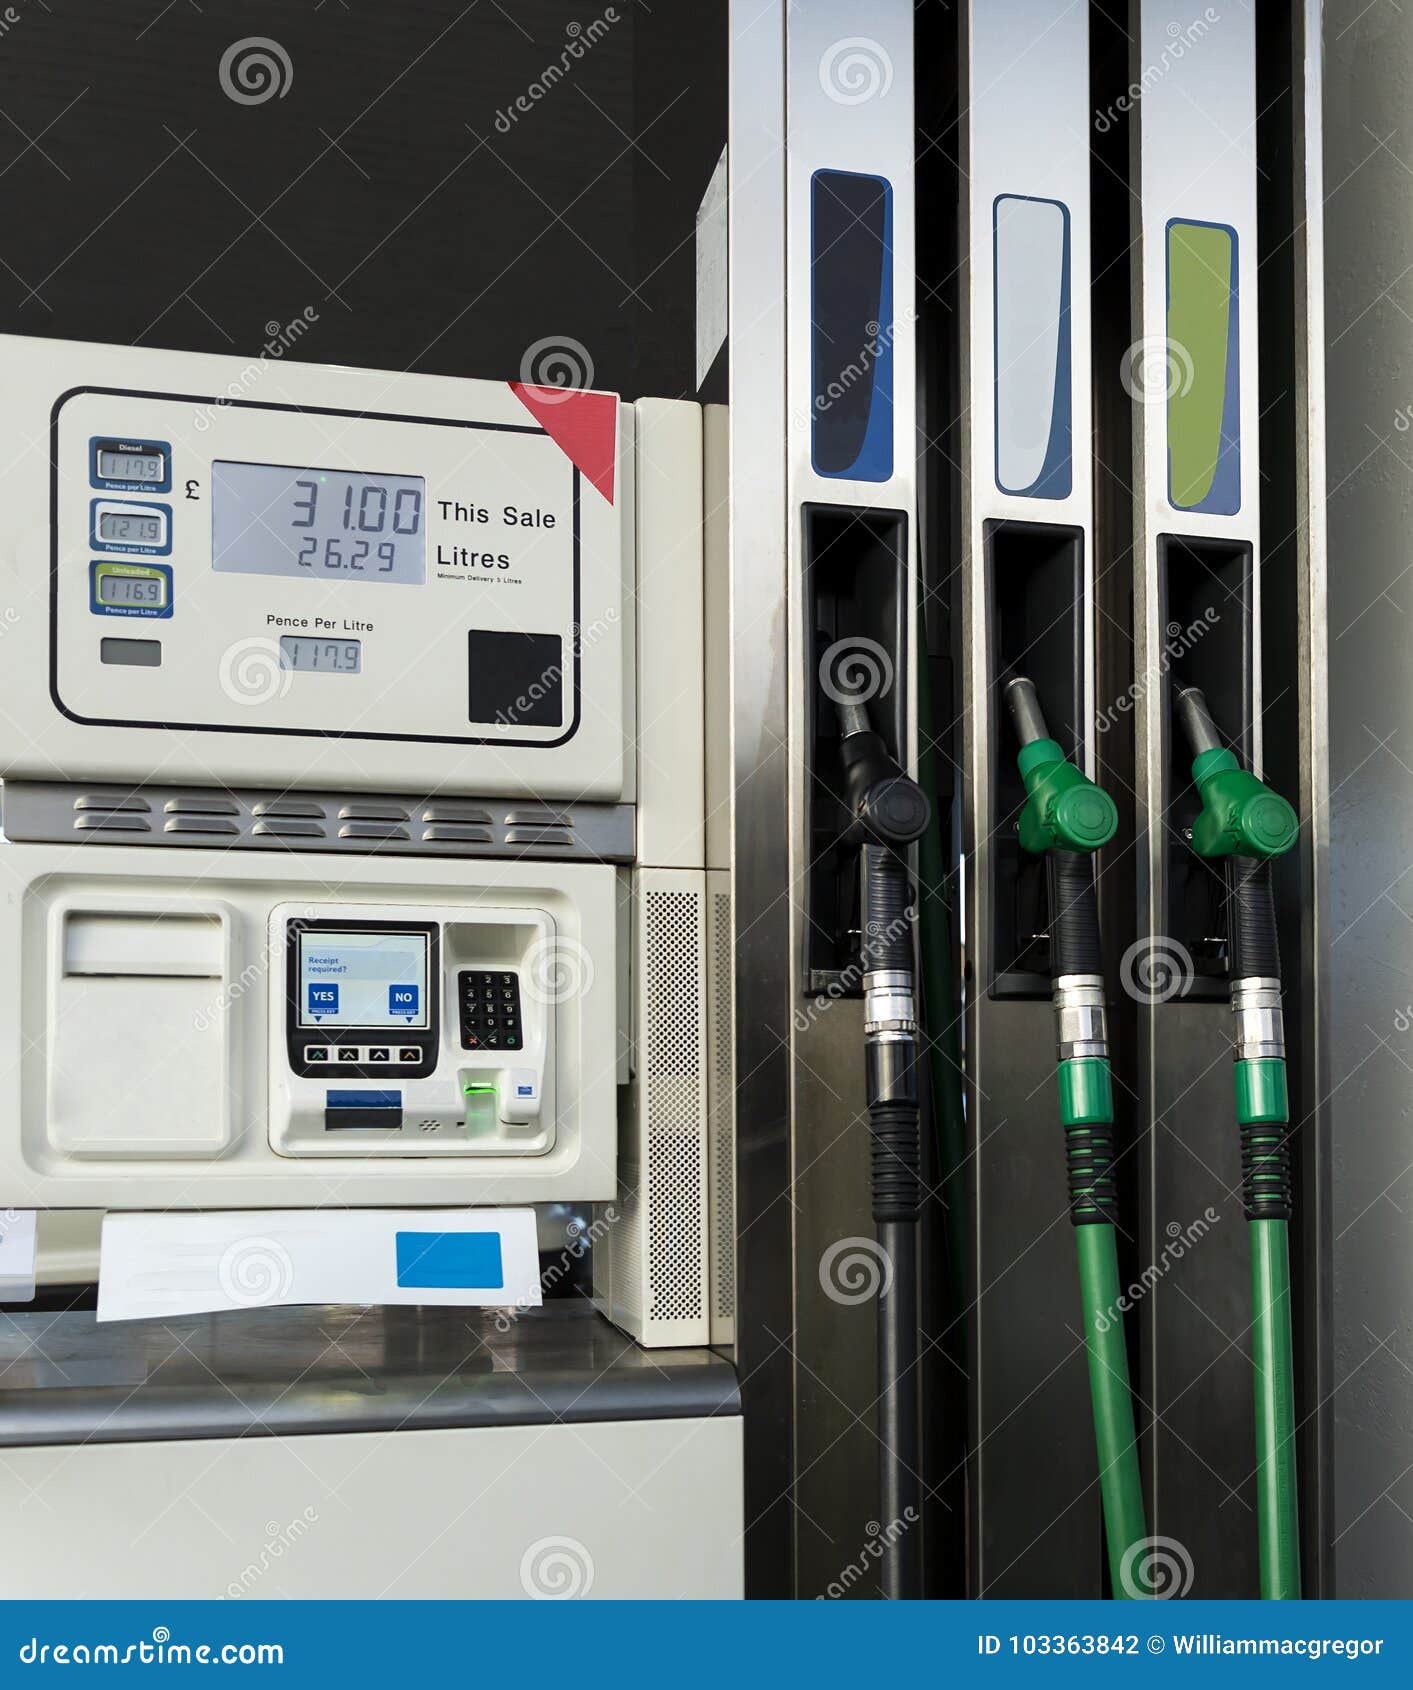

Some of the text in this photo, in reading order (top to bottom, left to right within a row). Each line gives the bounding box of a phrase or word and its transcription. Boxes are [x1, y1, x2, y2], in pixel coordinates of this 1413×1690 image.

[119, 444, 142, 452] Diesel
[112, 458, 158, 478] 117.9
[185, 480, 200, 500] £
[292, 480, 422, 534] 31.00
[438, 501, 556, 528] This Sale
[112, 520, 158, 539] 121.9
[105, 544, 127, 552] Pence
[140, 546, 156, 554] Litre
[298, 537, 394, 572] 26.29
[438, 545, 510, 570] Litres
[112, 567, 150, 576] Unleaded
[437, 572, 466, 580] Minimum
[468, 575, 494, 583] Delivery
[112, 582, 158, 600] 116.9
[105, 606, 127, 614] Pence
[140, 608, 158, 616] Litre
[266, 614, 374, 632] Pence Per Litre
[293, 644, 359, 670] 117.9
[308, 956, 338, 965] Receipt
[308, 966, 346, 974] required?
[312, 992, 334, 1001] YES
[395, 993, 412, 1002] NO
